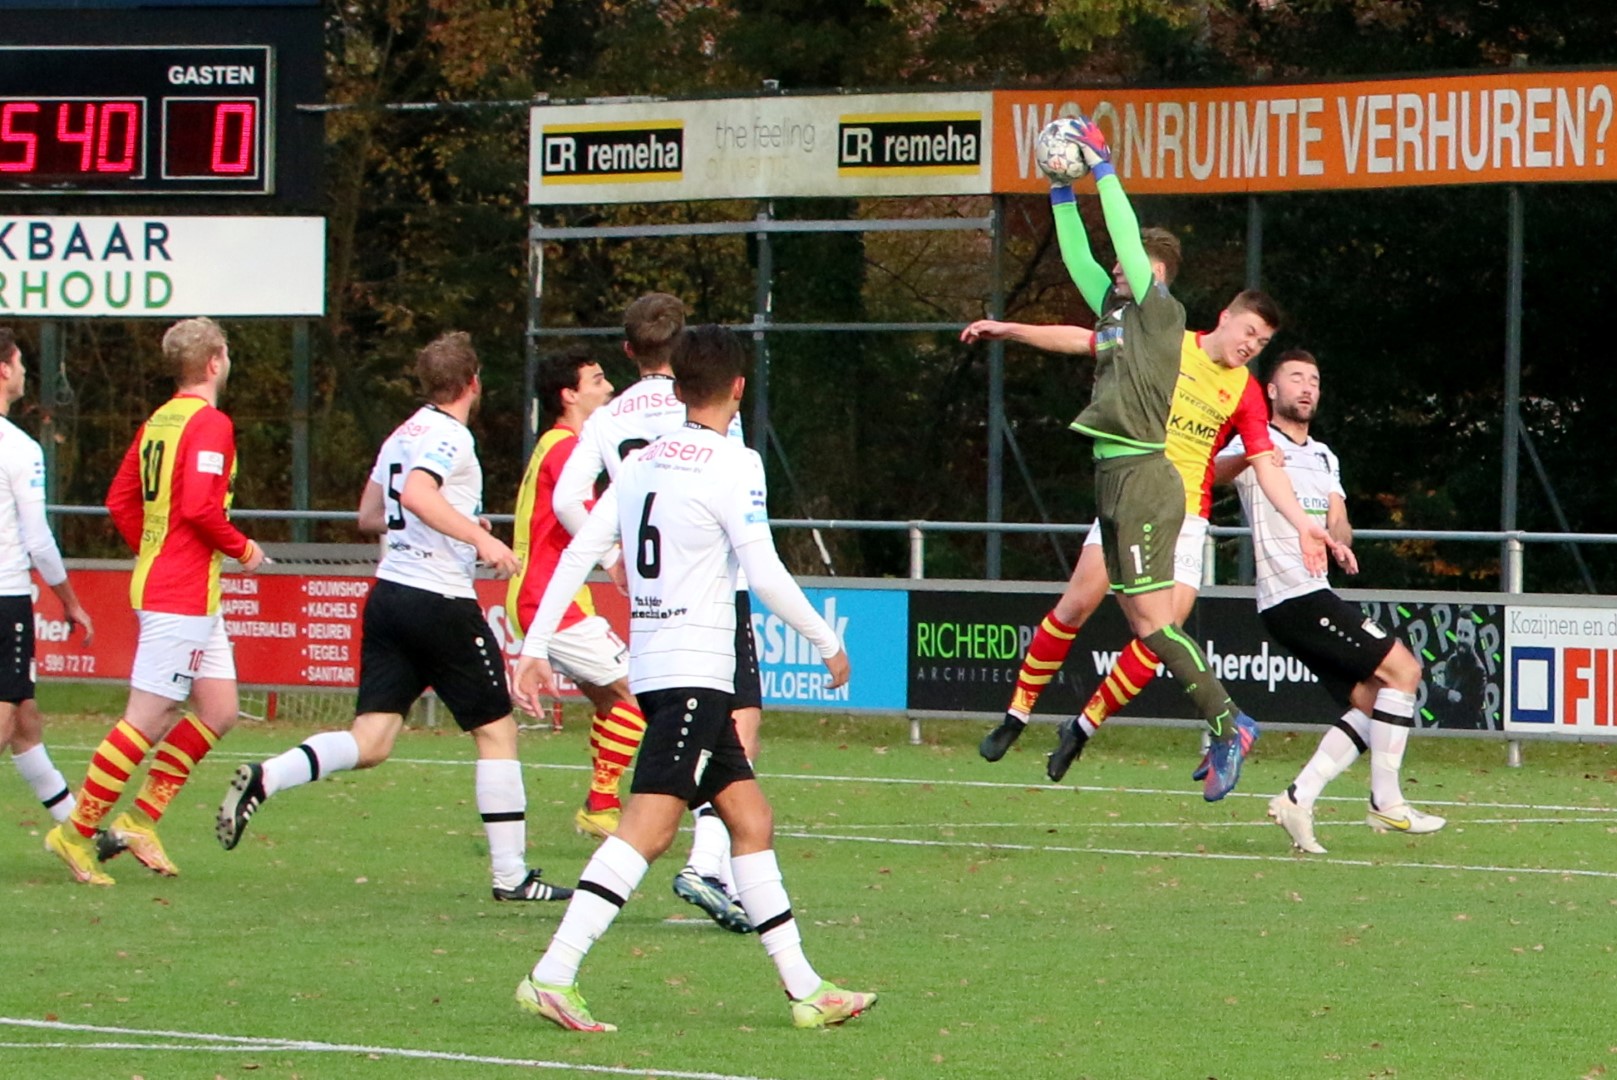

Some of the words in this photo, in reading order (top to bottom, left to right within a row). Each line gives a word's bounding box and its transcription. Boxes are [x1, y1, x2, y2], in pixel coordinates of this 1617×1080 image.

[168, 66, 254, 85] GASTEN
[57, 103, 137, 172] 40
[212, 103, 252, 172] 0
[716, 119, 747, 149] the
[753, 116, 815, 153] feeling
[884, 125, 977, 162] remeha
[1012, 98, 1324, 180] WONRUIMTE
[1337, 84, 1613, 174] VERHUREN?
[587, 133, 679, 171] remeha
[611, 393, 681, 417] Janse
[1169, 413, 1217, 441] KAMP
[143, 440, 165, 501] 10
[388, 463, 406, 530] 5
[637, 492, 661, 579] 6
[1130, 545, 1143, 574] 1
[308, 580, 370, 597] BOUWSHOP
[308, 602, 357, 618] KACHELS
[1510, 610, 1579, 639] Kozijnen
[1583, 619, 1603, 636] en
[308, 623, 352, 639] DEUREN
[917, 622, 1038, 661] RICHERDP
[308, 645, 349, 661] TEGELS
[308, 666, 355, 682] SANITAIR
[1563, 647, 1617, 726] FI
